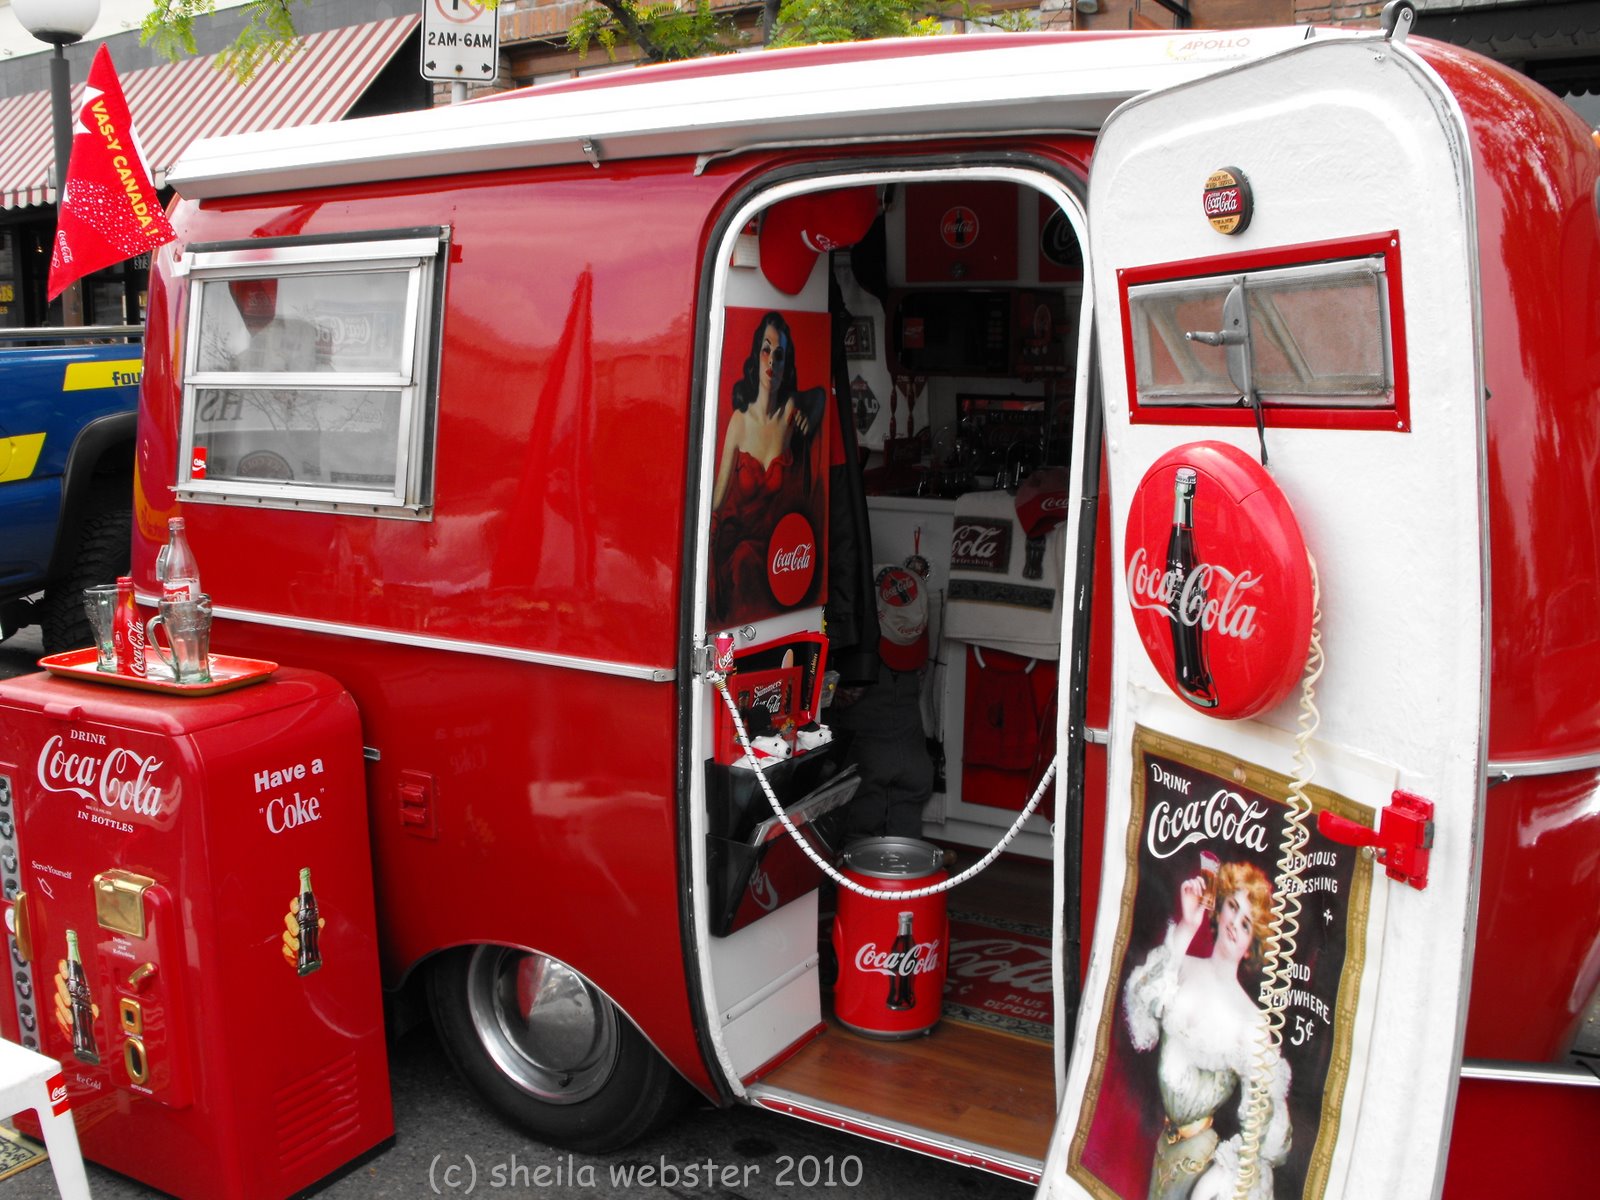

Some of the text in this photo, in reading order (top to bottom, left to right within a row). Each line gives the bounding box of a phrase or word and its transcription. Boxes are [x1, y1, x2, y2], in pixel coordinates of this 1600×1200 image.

[1180, 37, 1251, 51] APOLLO
[91, 100, 122, 150] VAS-Y
[772, 543, 811, 575] Coca-Cola
[1126, 547, 1264, 640] Coca-Cola
[128, 619, 145, 677] Coca-Cola
[70, 729, 106, 745] DRINK
[37, 734, 164, 817] Coca-Cola
[254, 758, 324, 793] Have a
[1151, 763, 1192, 795] DRINK
[77, 810, 89, 821] IN
[91, 814, 135, 834] BOTTLES
[1147, 788, 1269, 859] Coca-Cola
[1278, 877, 1338, 894] EFESHING
[854, 940, 940, 978] Coca-Cola
[1287, 963, 1311, 982] SOLD
[983, 999, 1048, 1019] DEPOSIT
[1003, 994, 1046, 1009] PLUS
